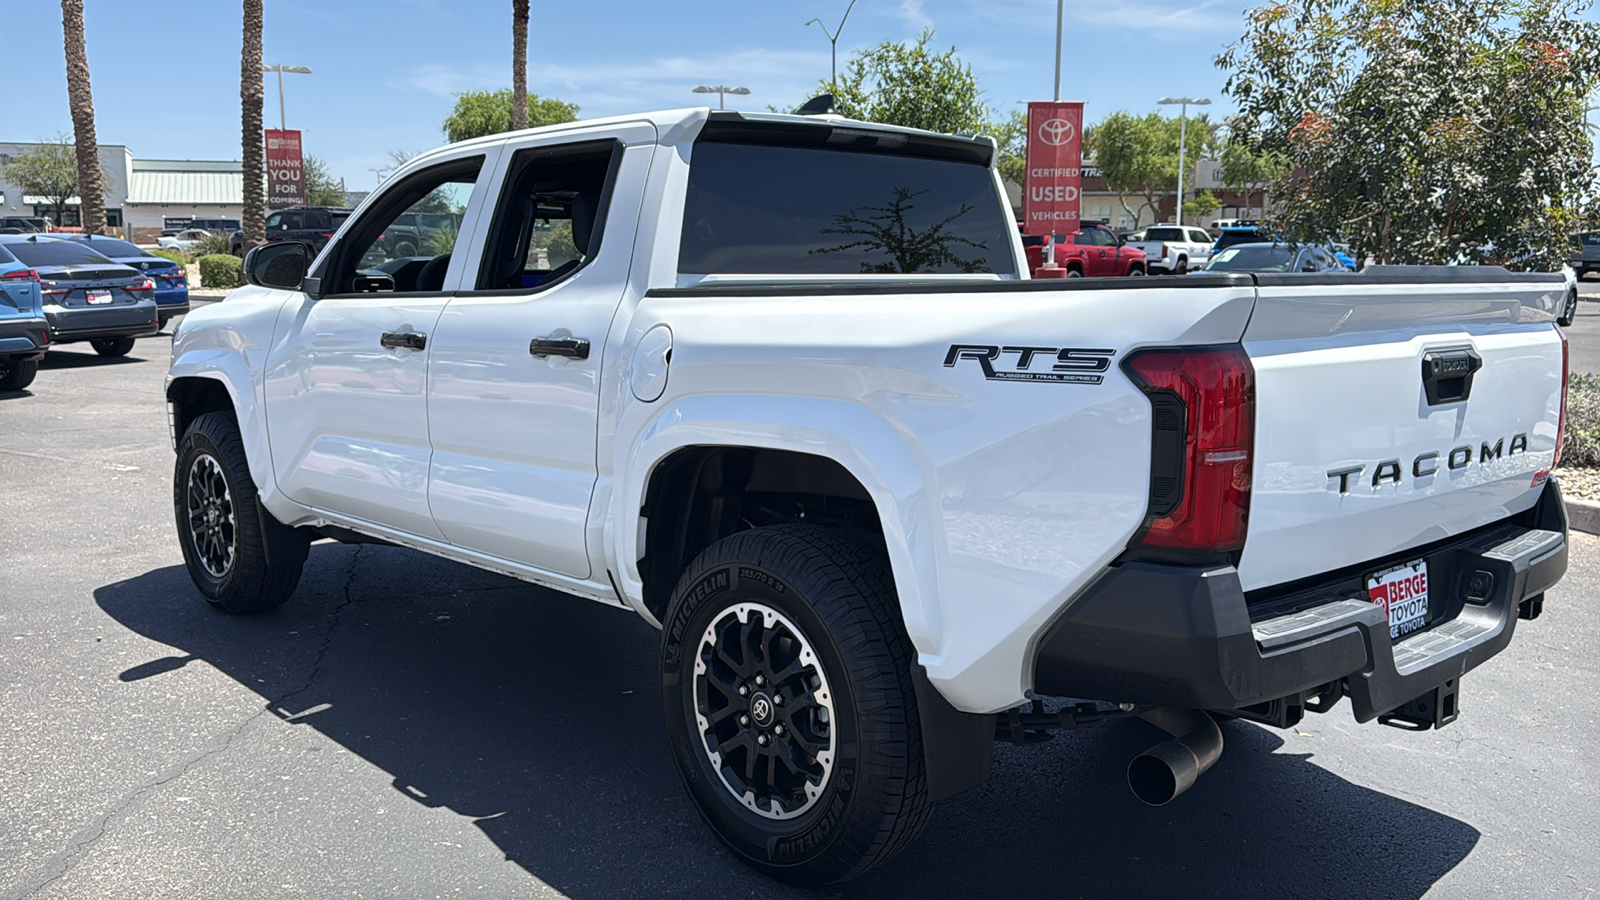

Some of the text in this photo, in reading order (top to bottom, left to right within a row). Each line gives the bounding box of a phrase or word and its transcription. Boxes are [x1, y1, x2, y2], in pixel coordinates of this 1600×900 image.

[268, 159, 302, 168] THANK
[1031, 167, 1079, 178] CERTIFIED
[269, 169, 301, 181] YOU
[275, 184, 298, 194] FOR
[1031, 186, 1078, 202] USED
[1031, 211, 1077, 221] VEHICLES
[943, 344, 1117, 378] RTS
[1326, 432, 1528, 495] TACOMA
[740, 568, 767, 583] 265/70
[767, 577, 774, 586] R
[1388, 572, 1427, 604] BERGE
[671, 572, 727, 642] MICHELIN
[1390, 597, 1428, 624] TOYOTA
[1400, 616, 1426, 636] TOYOTA
